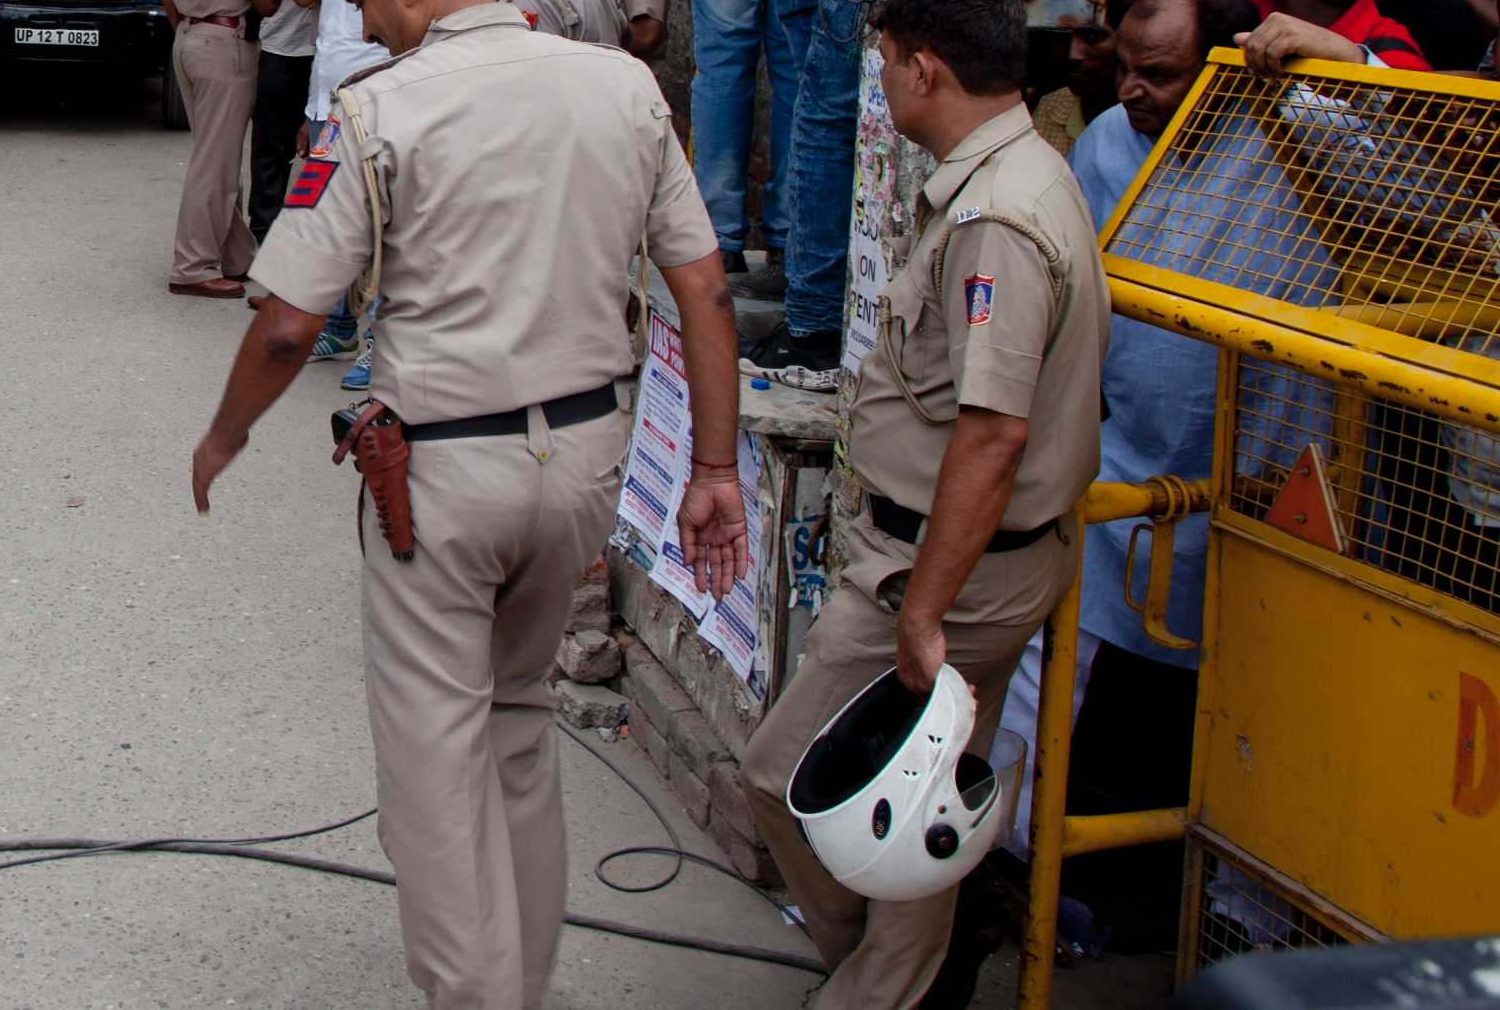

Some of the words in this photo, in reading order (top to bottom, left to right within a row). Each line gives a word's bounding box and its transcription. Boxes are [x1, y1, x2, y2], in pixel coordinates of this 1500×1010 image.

[16, 29, 33, 42] UP
[37, 30, 52, 43] 12
[56, 31, 64, 43] T
[68, 32, 98, 45] 0823
[860, 255, 876, 282] ON
[1451, 670, 1500, 819] D
